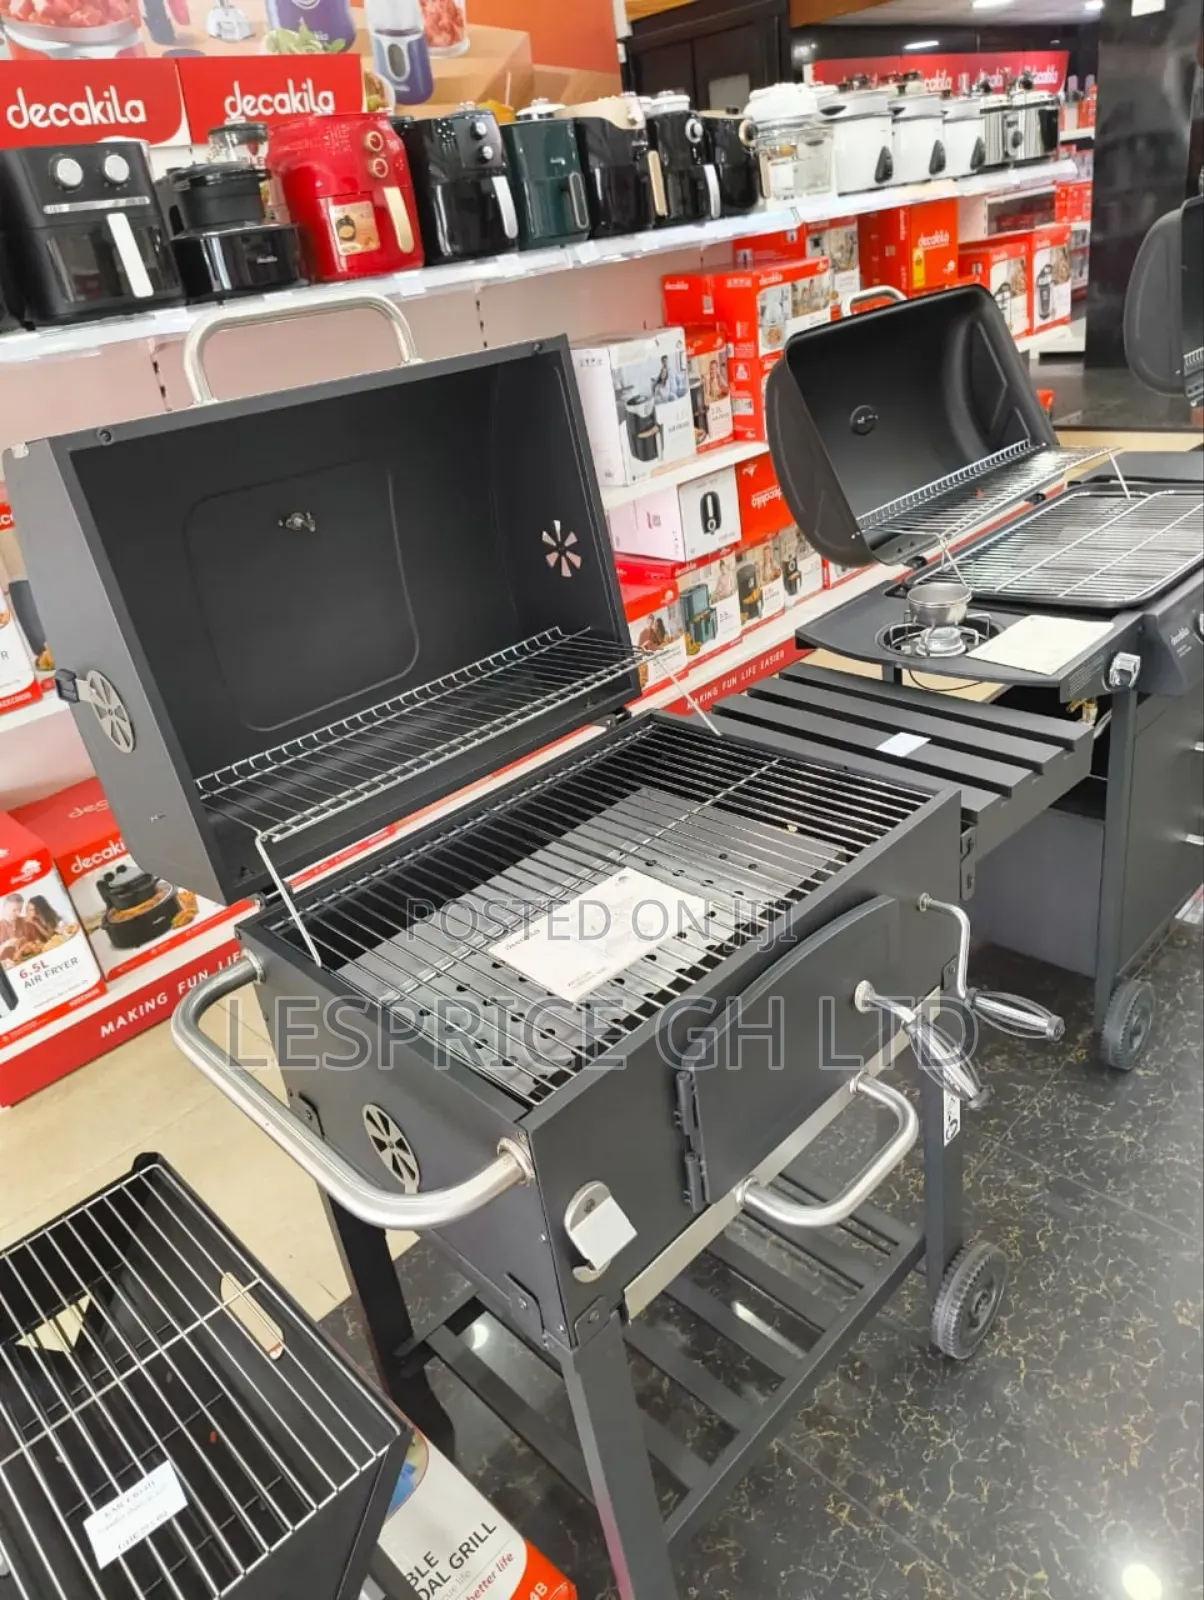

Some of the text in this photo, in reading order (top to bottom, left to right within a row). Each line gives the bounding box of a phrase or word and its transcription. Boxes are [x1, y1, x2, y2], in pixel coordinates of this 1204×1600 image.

[6, 86, 147, 129] decakila
[224, 77, 336, 117] decakila
[71, 837, 126, 874] decaki
[19, 959, 50, 980] 6.5L
[24, 955, 79, 990] AIR FRYER
[100, 991, 168, 1038] MAKING
[177, 969, 210, 996] FUN
[448, 1522, 497, 1569] GRILL
[495, 1552, 514, 1573] life
